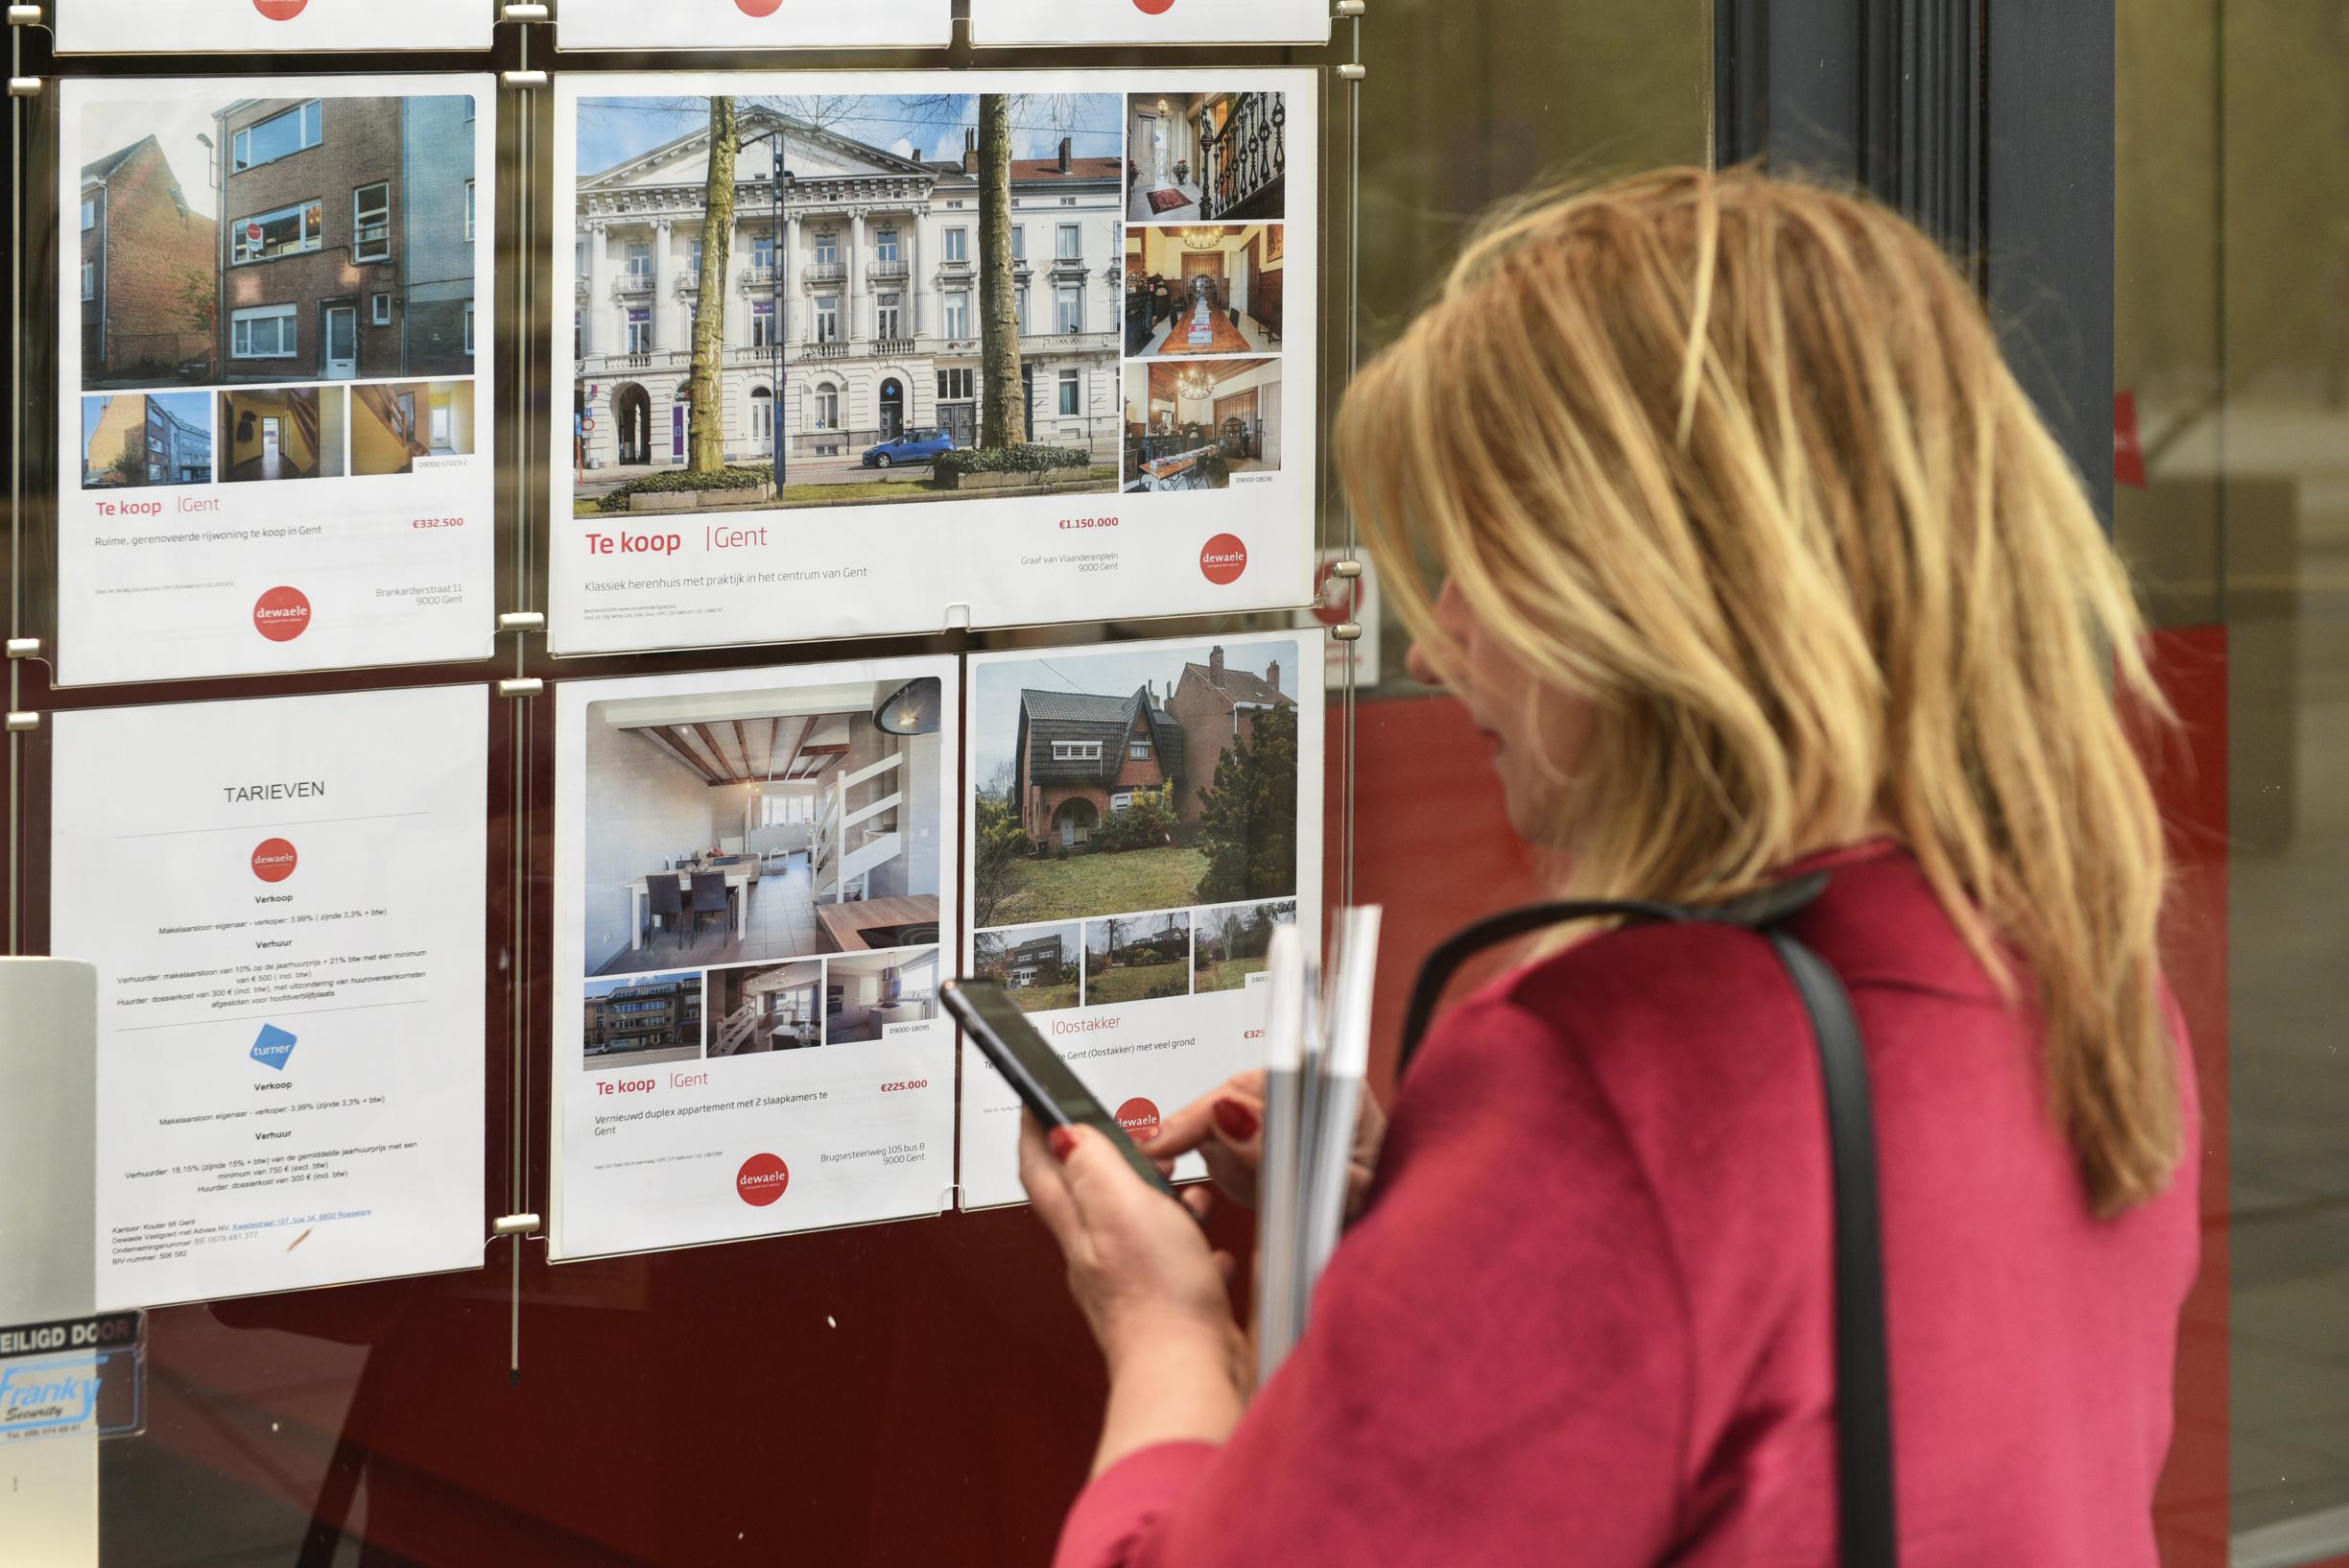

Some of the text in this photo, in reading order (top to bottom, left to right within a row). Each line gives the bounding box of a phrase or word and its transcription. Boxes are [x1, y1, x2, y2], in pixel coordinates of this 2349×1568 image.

[95, 496, 221, 516] Te koop Gent
[413, 517, 463, 529] €332.500
[1059, 517, 1119, 530] €1.150.000
[131, 532, 201, 547] gerenoveerde
[202, 530, 249, 542] rijwoning
[262, 528, 286, 537] koop
[287, 526, 297, 535] in
[298, 526, 322, 535] Gent
[585, 525, 769, 556] Te koop Gent
[1021, 556, 1042, 565] Graaf
[1059, 552, 1118, 563] Vlaanderenplein
[1203, 552, 1245, 563] dewaele
[1078, 562, 1118, 573] 9000 Gent
[584, 567, 867, 592] Klassiek herenhuis met praktijk in het centrum van Gent
[376, 583, 463, 597] Brankardierstraat 11
[416, 595, 463, 606] 9000 Gent
[257, 606, 308, 619] dewaele
[224, 781, 324, 803] TARIEVEN
[254, 853, 295, 865] dewaele
[254, 895, 294, 904] Verkoop
[158, 924, 213, 935] Makelaarsloon
[214, 921, 248, 931] eigenaar
[320, 913, 343, 921] zijnde
[370, 908, 388, 916] btw)
[255, 939, 293, 949] Verhuur
[163, 969, 219, 980] makelaarsloon
[275, 960, 321, 971] jaarhuurprijs
[296, 970, 312, 979] btw)
[151, 992, 195, 1003] dossierkost
[289, 980, 334, 993] uitzondering
[211, 999, 249, 1010] afgesloten
[1056, 1015, 1121, 1034] Oostakker
[253, 1044, 292, 1056] turner
[984, 1060, 994, 1070] Te
[1068, 1051, 1086, 1060] Gent
[1088, 1044, 1135, 1058] (Oostakker)
[1136, 1043, 1152, 1052] met
[1153, 1039, 1171, 1050] veel
[1172, 1036, 1195, 1050] grond
[254, 1081, 293, 1091] Verkoop
[596, 1071, 709, 1096] Te koop Gent
[881, 1080, 928, 1092] €225.000
[159, 1115, 214, 1126] Makelaarsloon
[215, 1111, 248, 1121] eigenaar
[316, 1101, 340, 1110] (zijnde
[595, 1111, 643, 1125] Vernieuwd
[645, 1108, 676, 1119] duplex
[676, 1101, 735, 1117] appartement
[736, 1099, 754, 1108] met
[755, 1097, 762, 1106] 2
[763, 1093, 818, 1105] slaapkamers
[254, 1130, 292, 1140] Verhuur
[594, 1126, 616, 1136] Gent
[201, 1162, 226, 1173] (zijnde
[228, 1159, 245, 1168] 15%
[297, 1150, 341, 1162] gemiddelde
[341, 1144, 387, 1157] jaarhuurprijs
[820, 1147, 887, 1162] Brugsesteenweg
[888, 1145, 902, 1154] 105
[919, 1142, 925, 1151] B
[883, 1153, 925, 1166] 9000 Gent
[217, 1171, 251, 1180] minimum
[268, 1166, 283, 1175] 750
[313, 1161, 329, 1171] btw)
[231, 1178, 273, 1190] dossierkost
[291, 1174, 305, 1183] 300
[332, 1170, 348, 1178] btw)
[740, 1171, 786, 1185] dewaele
[144, 1230, 178, 1241] Vastgoed
[0, 1319, 130, 1353] EILIGD DOOR
[5, 1405, 63, 1422] Security
